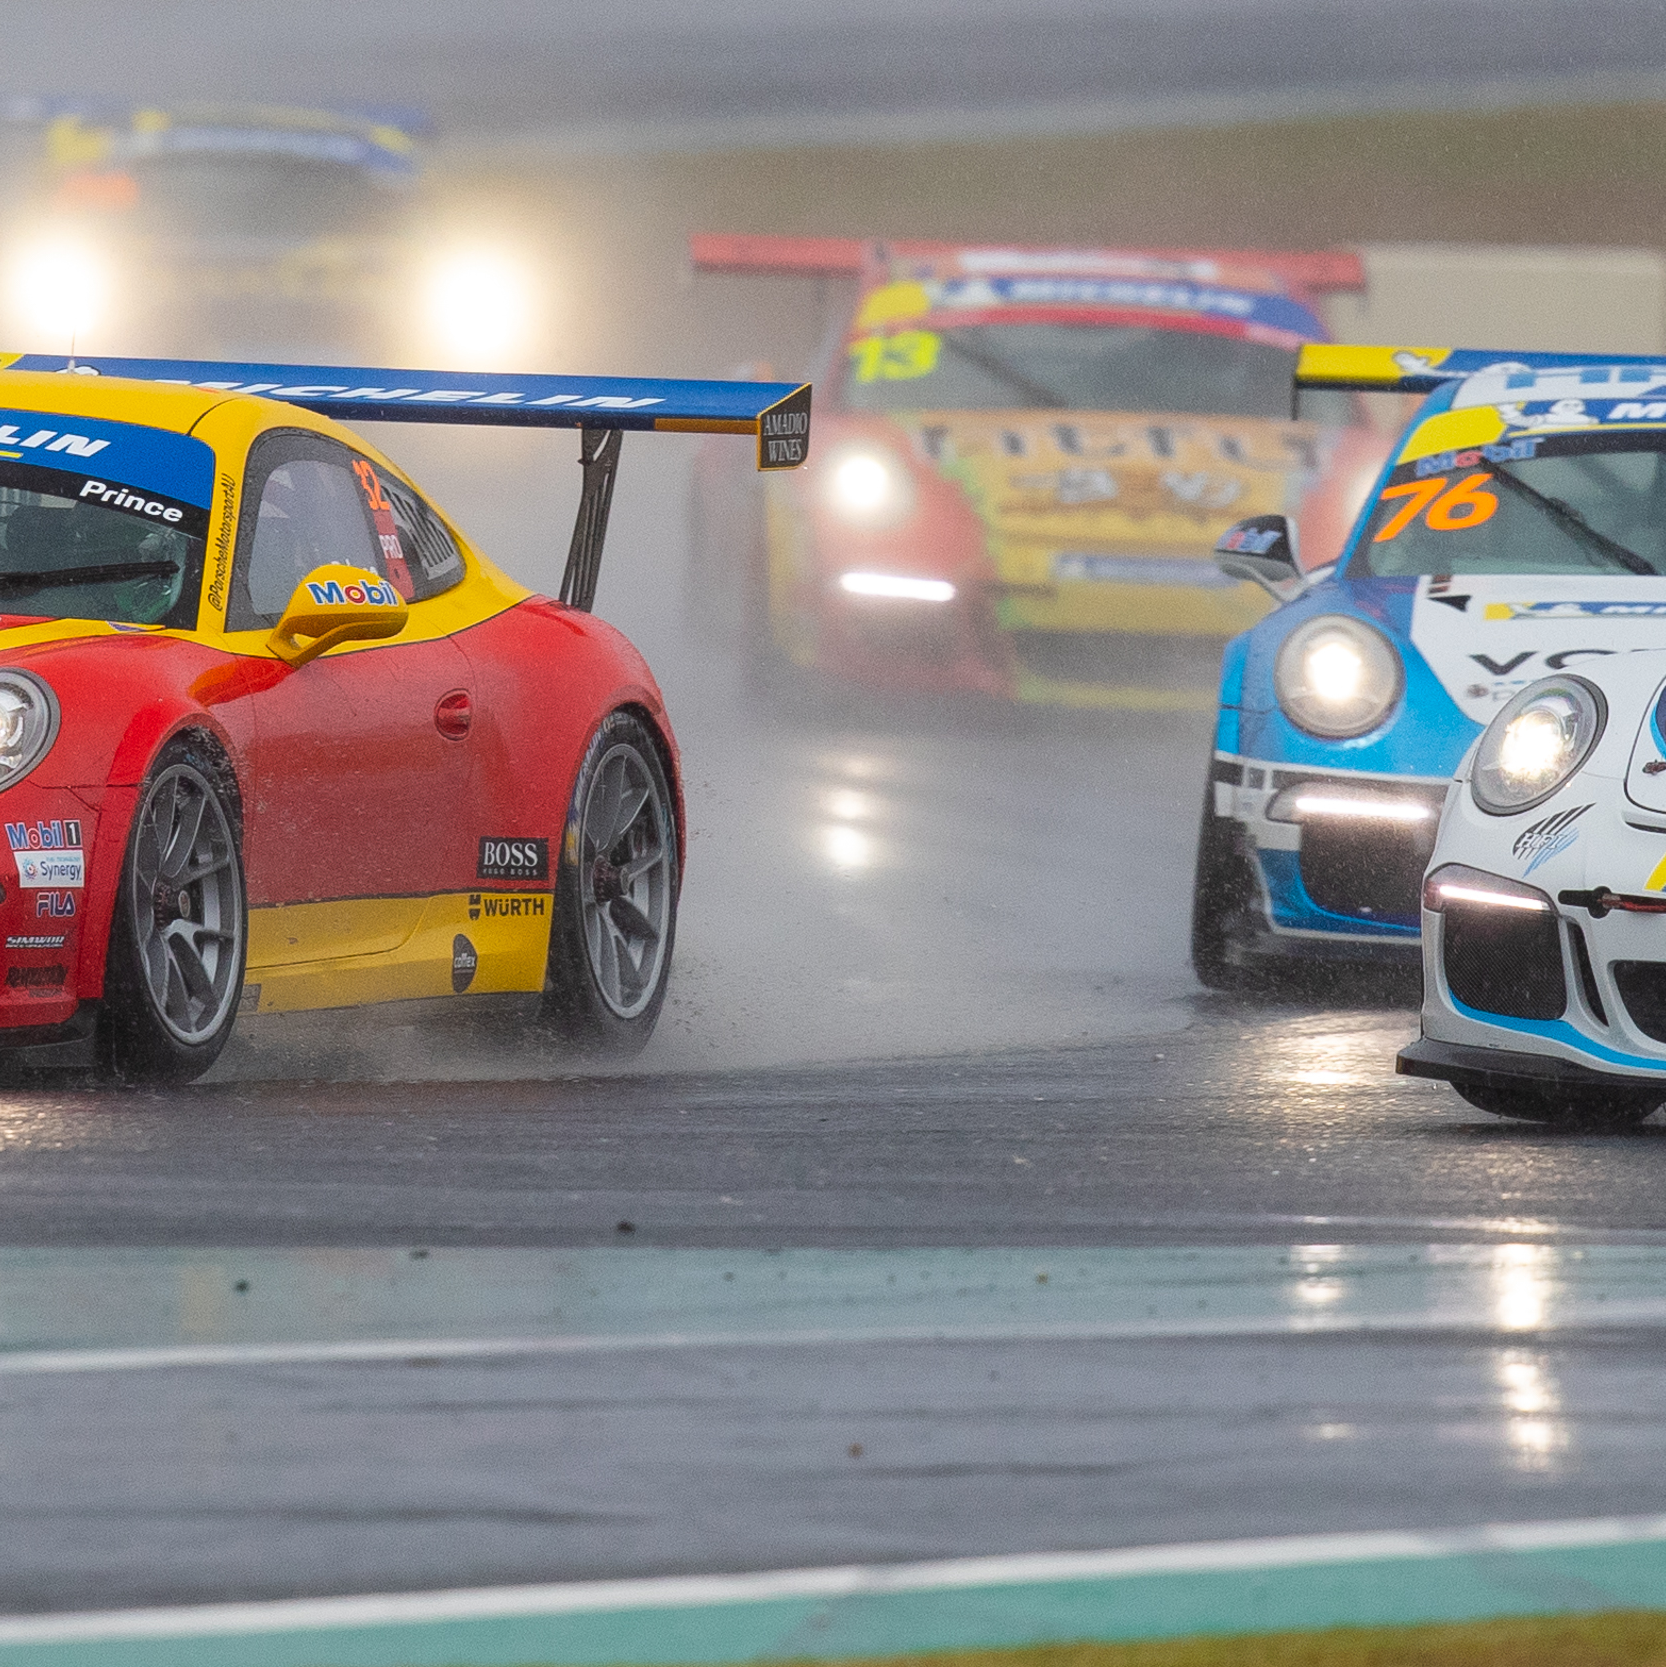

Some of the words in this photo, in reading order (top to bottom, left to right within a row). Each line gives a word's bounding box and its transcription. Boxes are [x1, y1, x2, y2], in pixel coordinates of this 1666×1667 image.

[850, 330, 939, 382] 13
[763, 412, 808, 436] AMADIO
[768, 439, 802, 462] WINES
[1416, 438, 1544, 477] Mobil
[351, 459, 390, 511] 32
[79, 480, 184, 522] Prince
[1373, 473, 1498, 542] 76
[207, 473, 237, 612] @PorscheMotorsportAU
[378, 534, 404, 559] PRO
[307, 580, 399, 606] Mobil
[4, 820, 64, 849] Mobil
[64, 819, 82, 848] 1
[483, 842, 538, 867] BOSS
[40, 860, 81, 880] Synergy
[37, 891, 75, 917] FILA
